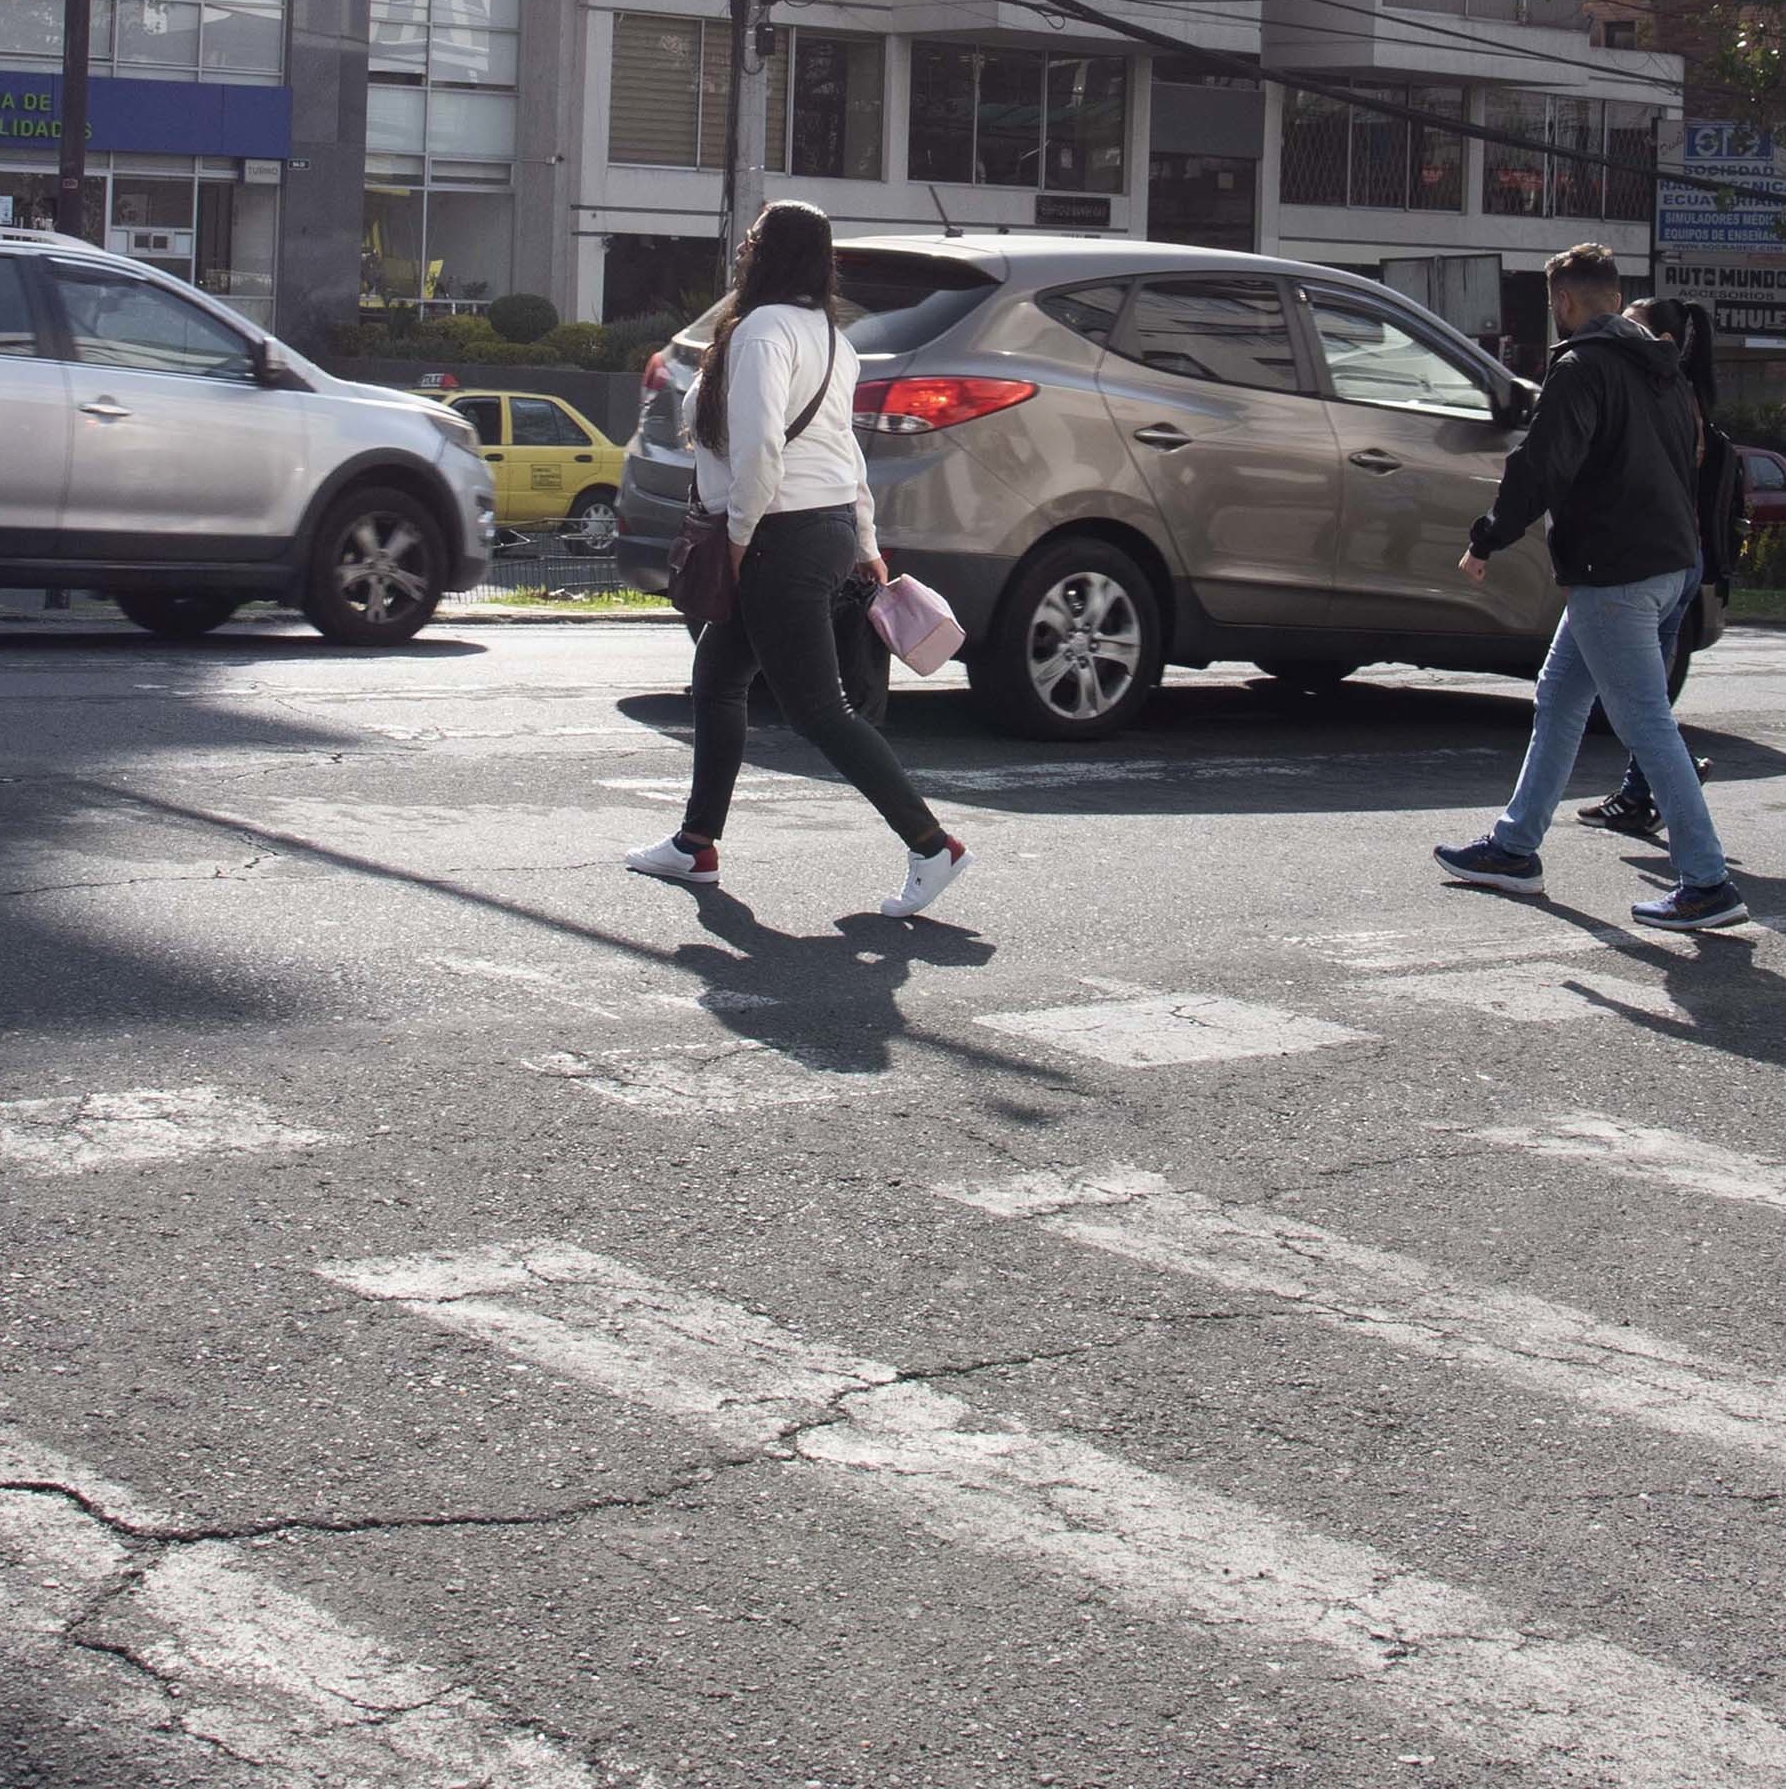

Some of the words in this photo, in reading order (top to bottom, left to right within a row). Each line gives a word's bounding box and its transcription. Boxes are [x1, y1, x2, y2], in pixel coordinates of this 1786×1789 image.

[24, 93, 52, 112] DE
[1684, 165, 1774, 177] SOCIEDAD
[1665, 211, 1740, 226] SIMULADORES
[1665, 227, 1708, 241] EQUIPOS
[1711, 229, 1725, 241] DE
[1678, 289, 1775, 301] ACCESORIOS
[1717, 308, 1786, 330] THULE
